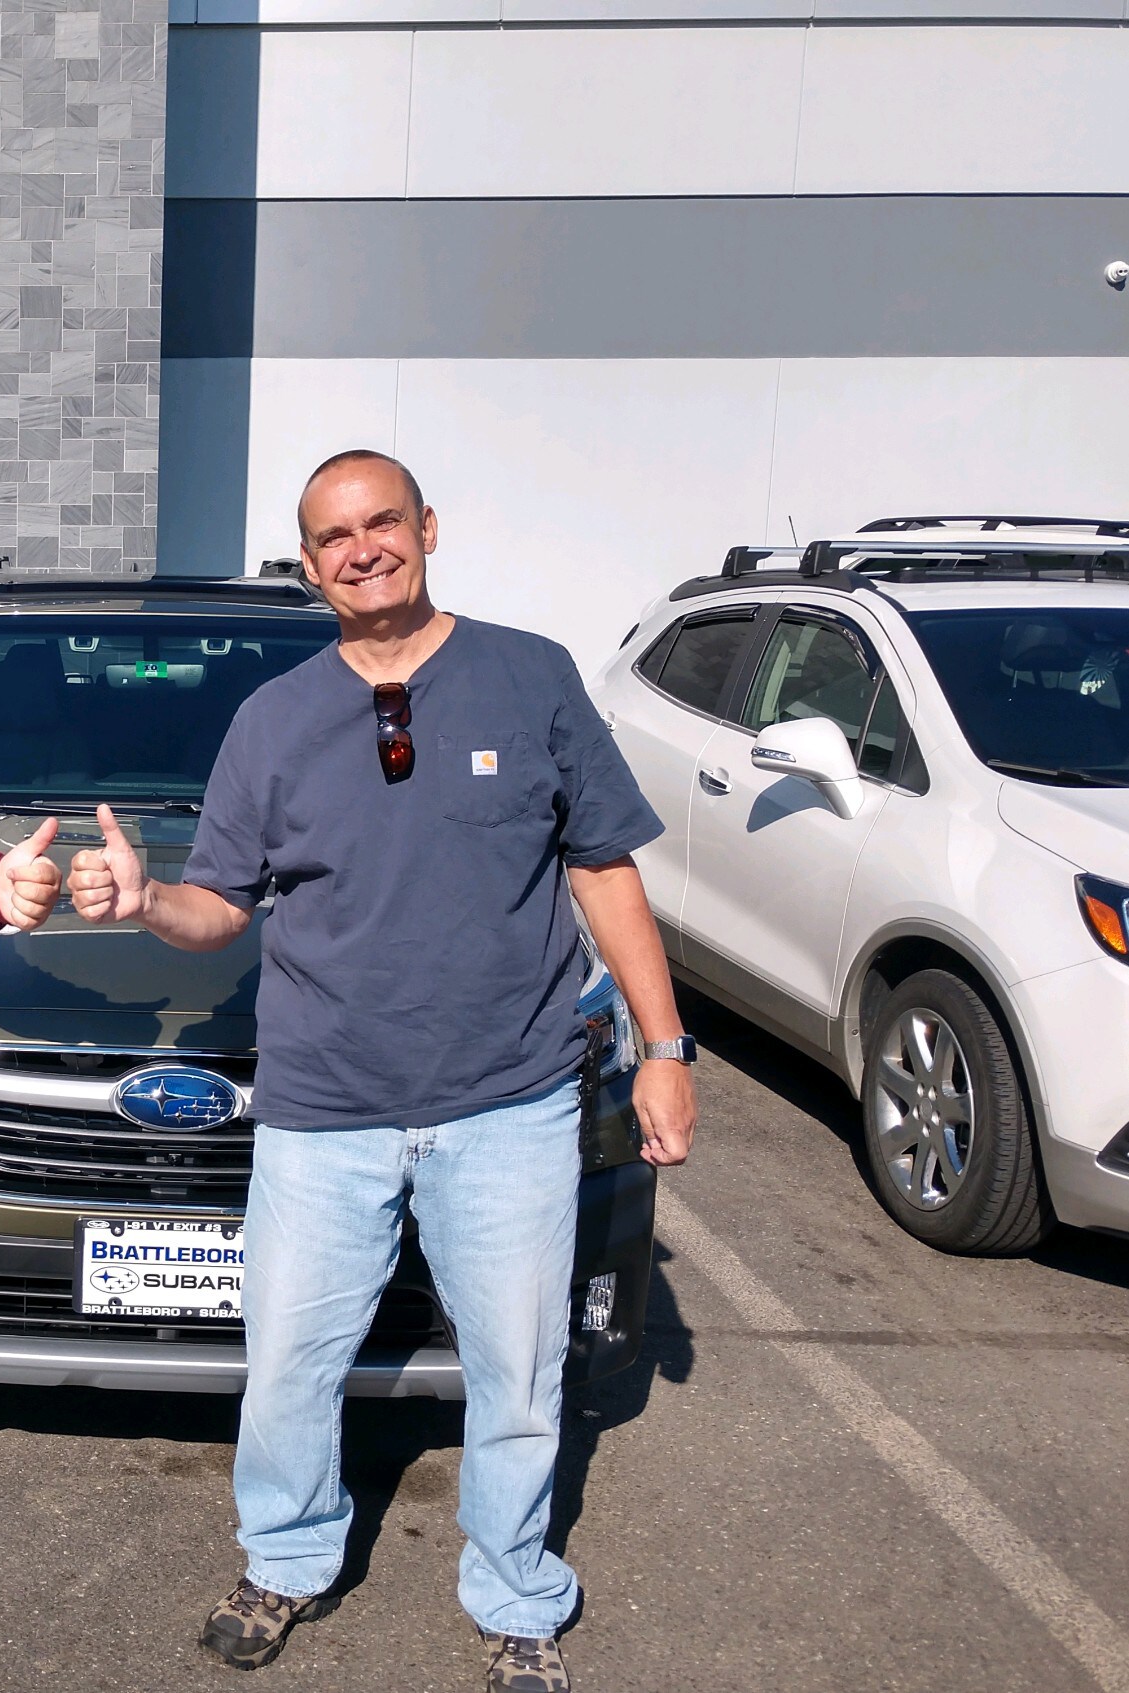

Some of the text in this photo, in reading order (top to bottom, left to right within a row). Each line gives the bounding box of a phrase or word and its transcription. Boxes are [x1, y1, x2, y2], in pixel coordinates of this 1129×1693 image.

[124, 1221, 222, 1232] I-91 VT EXIT #3
[143, 1273, 240, 1290] SUBAR
[82, 1304, 180, 1317] BRATTLEBORO
